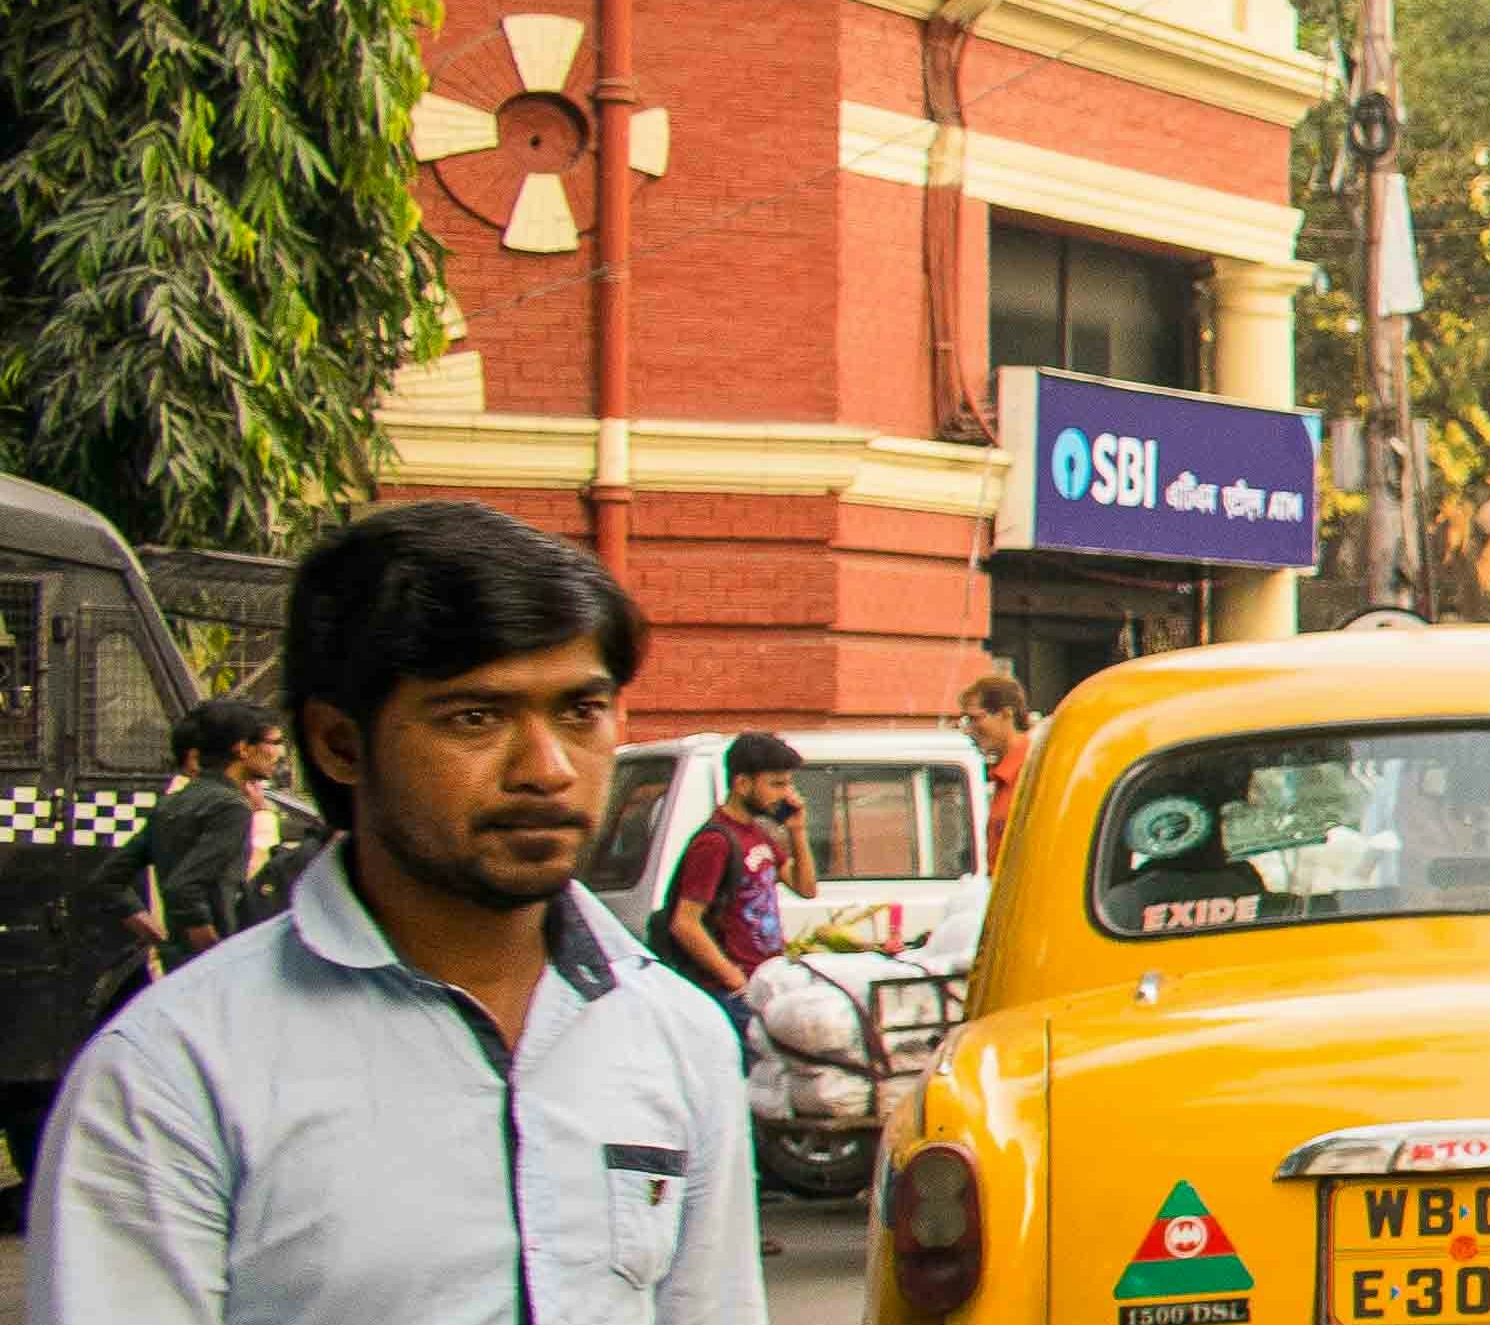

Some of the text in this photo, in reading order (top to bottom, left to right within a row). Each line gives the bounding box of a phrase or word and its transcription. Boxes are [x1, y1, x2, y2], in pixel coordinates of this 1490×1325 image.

[1091, 432, 1157, 508] SBI
[1267, 490, 1303, 522] ATM
[1142, 893, 1259, 932] EXIDE
[1364, 1187, 1453, 1239] WB
[1191, 1301, 1247, 1323] DSL
